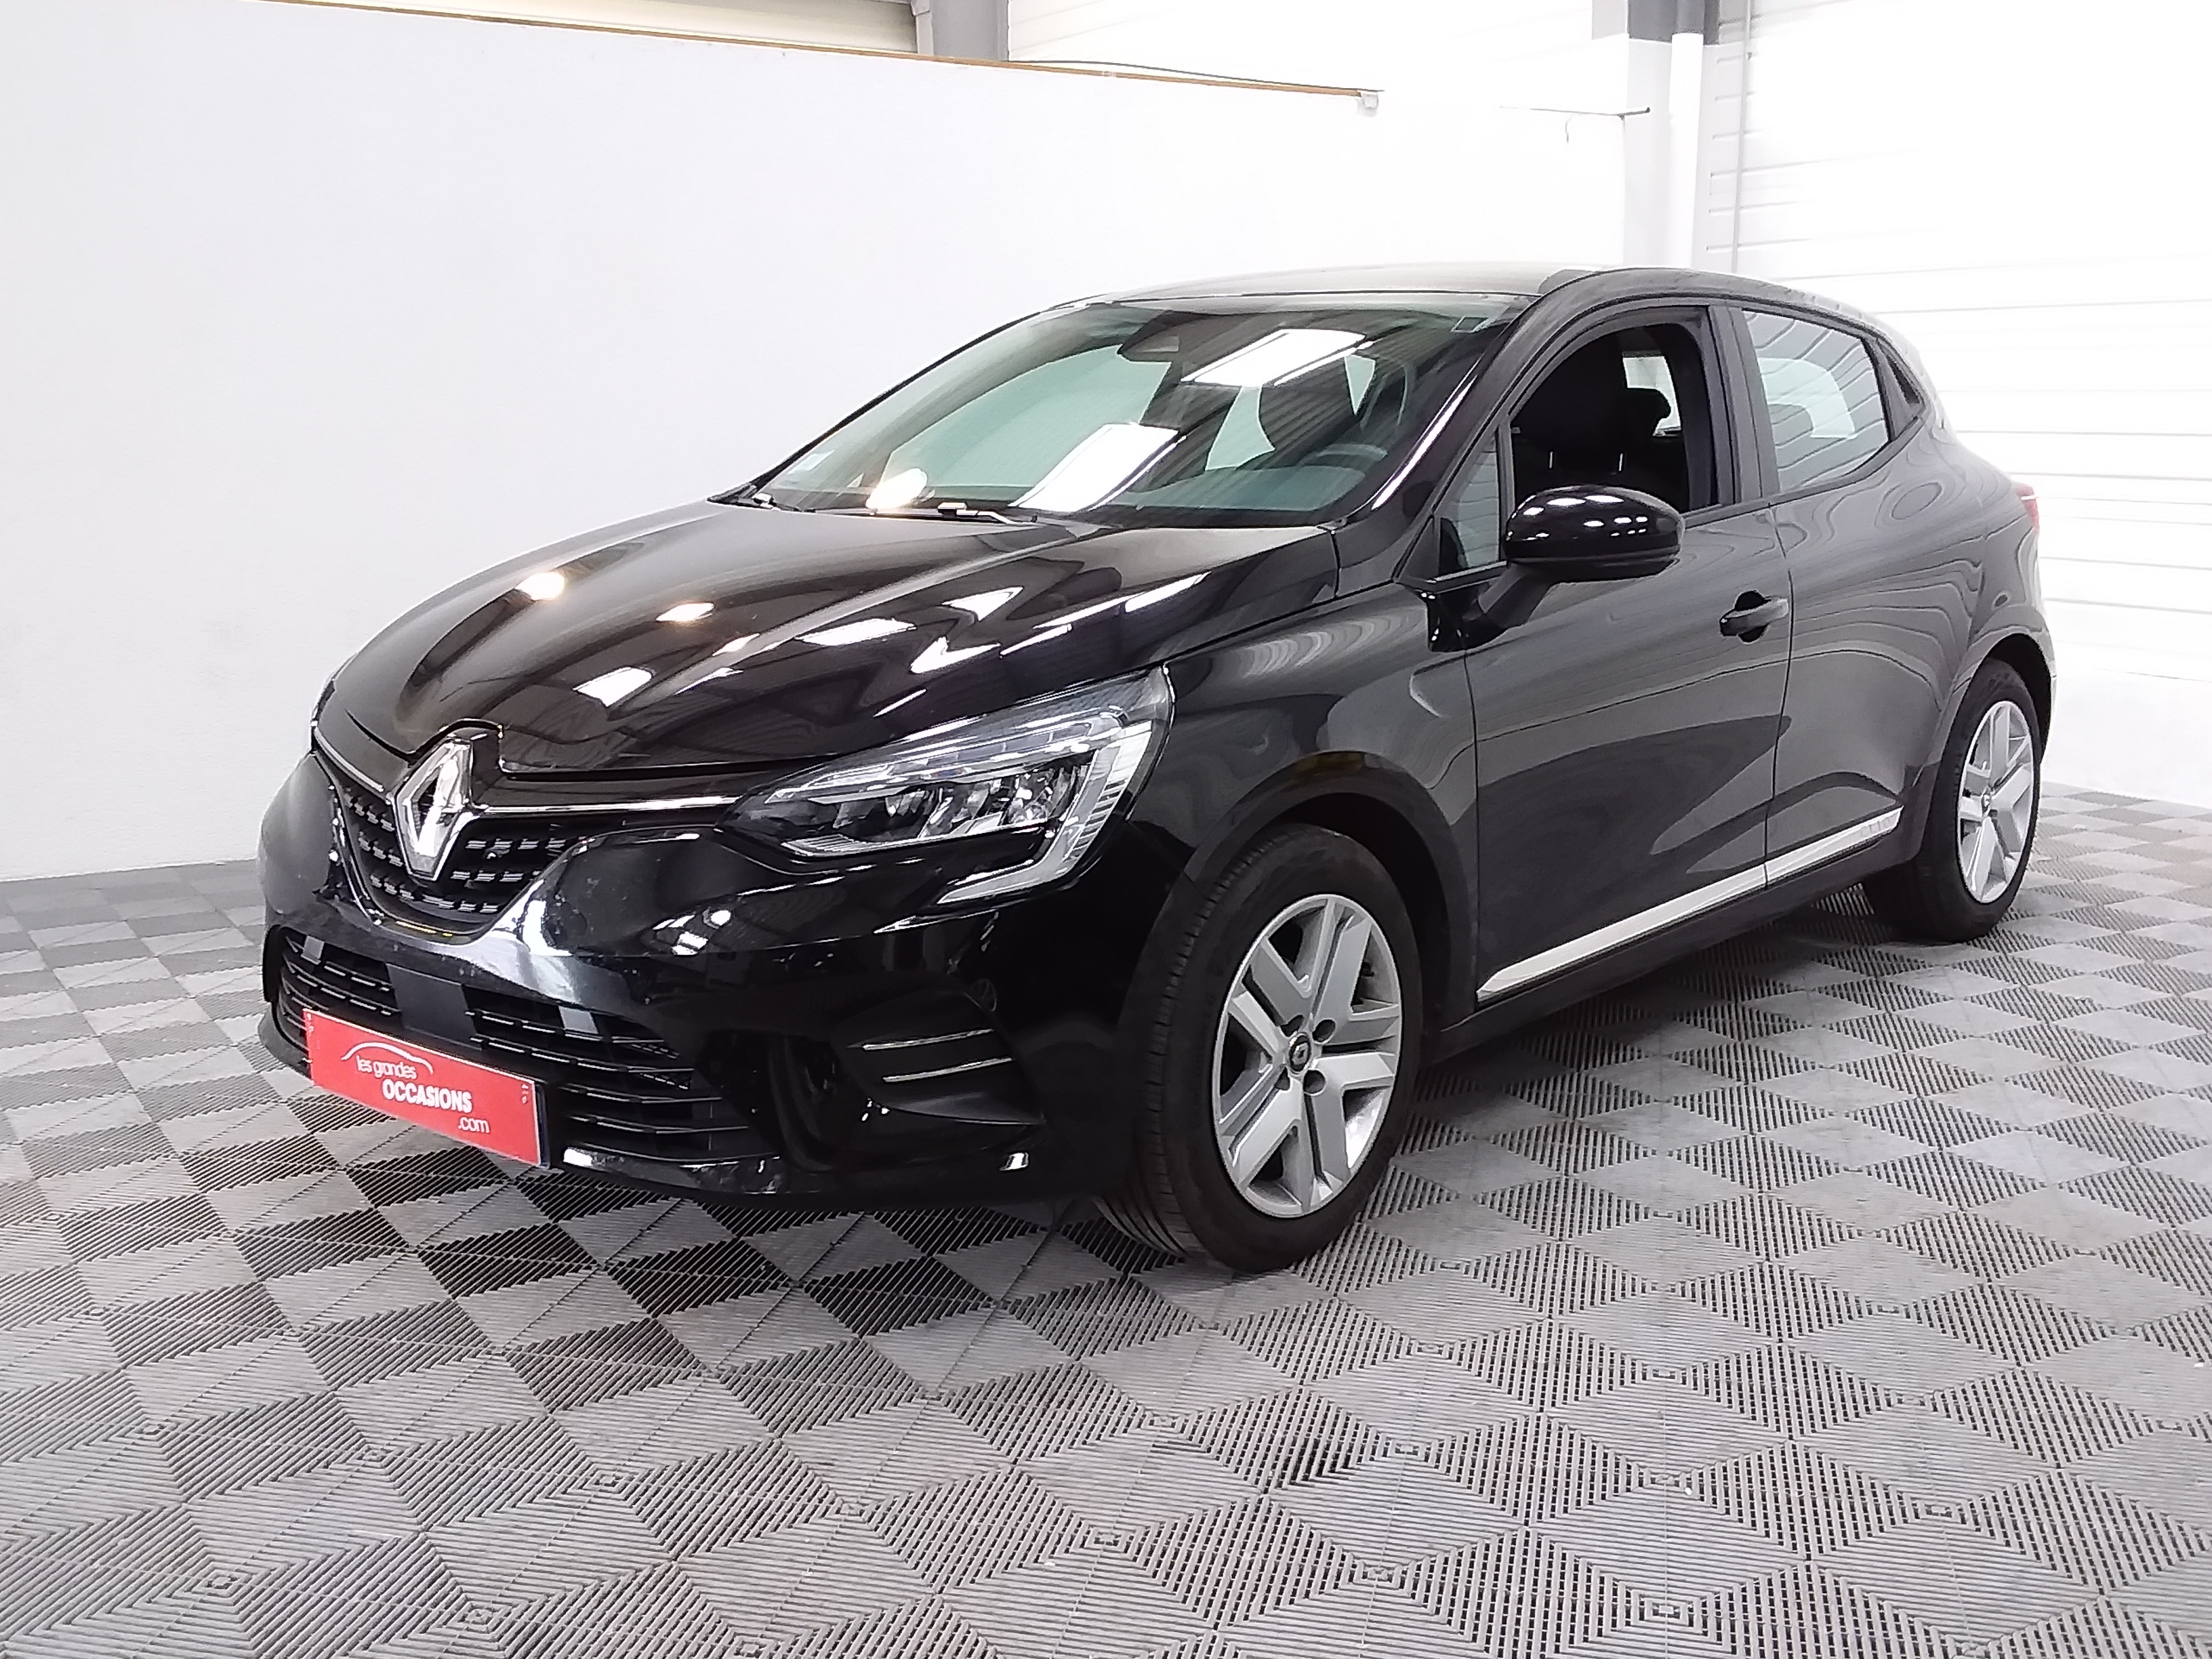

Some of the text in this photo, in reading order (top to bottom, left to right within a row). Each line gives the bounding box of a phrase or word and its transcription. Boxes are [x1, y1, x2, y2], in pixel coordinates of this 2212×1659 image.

[356, 1055, 417, 1080] les grandes
[382, 1078, 473, 1113] OCCASIONS
[458, 1117, 491, 1134] .com
